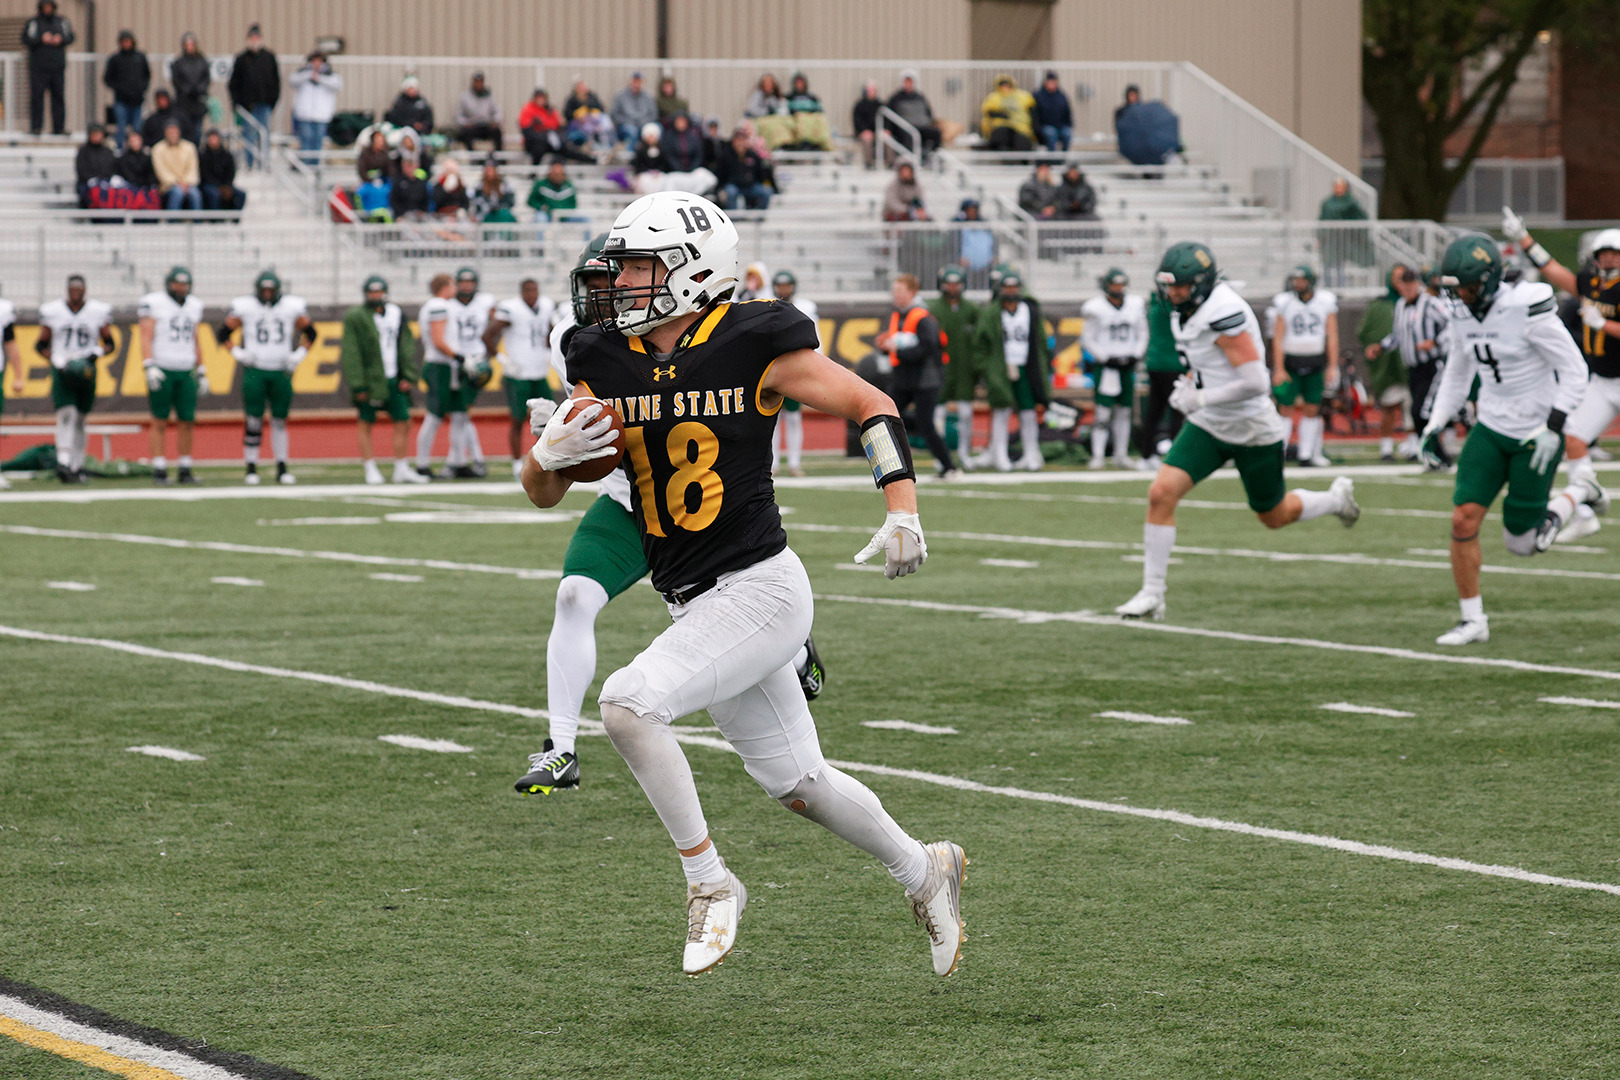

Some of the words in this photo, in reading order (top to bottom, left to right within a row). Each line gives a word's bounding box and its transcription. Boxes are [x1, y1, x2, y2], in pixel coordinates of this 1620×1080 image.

[677, 206, 712, 234] 18
[61, 324, 90, 349] 76
[256, 317, 284, 344] 63
[1473, 344, 1502, 383] 4
[673, 387, 745, 417] STATE
[624, 421, 724, 538] 18
